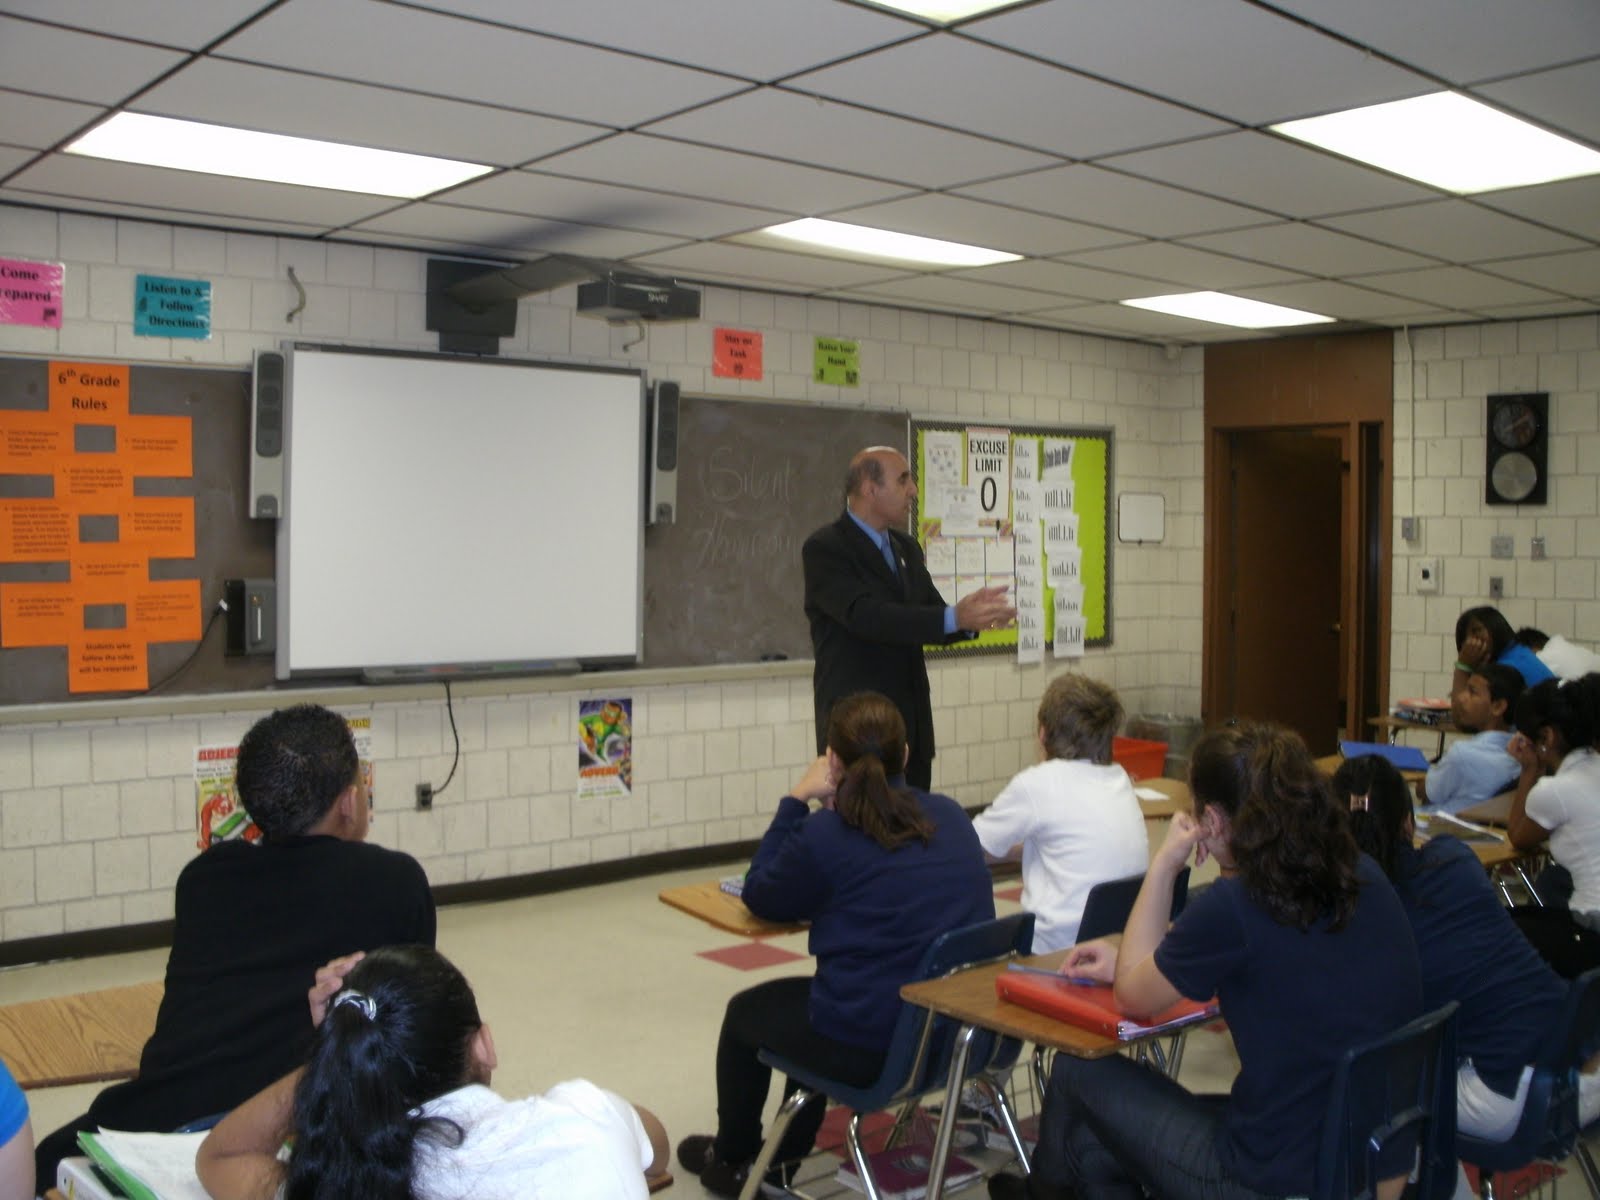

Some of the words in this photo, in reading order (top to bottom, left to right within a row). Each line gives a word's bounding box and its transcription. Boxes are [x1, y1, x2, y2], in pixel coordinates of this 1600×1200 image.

[0, 266, 39, 280] Come
[145, 281, 177, 295] Listen
[180, 286, 191, 297] to
[194, 287, 203, 297] &
[161, 298, 194, 313] Follow
[149, 315, 205, 329] Directions
[724, 334, 740, 346] Stay
[818, 341, 838, 352] Raise
[730, 348, 747, 359] Task
[827, 355, 846, 367] Hand
[58, 368, 77, 386] 6th
[80, 373, 120, 387] Grade
[72, 396, 108, 410] Rules
[969, 439, 1008, 455] EXCUSE
[975, 458, 1003, 472] LIMIT
[709, 446, 792, 503] Silent
[980, 476, 998, 513] 0
[105, 653, 116, 661] the
